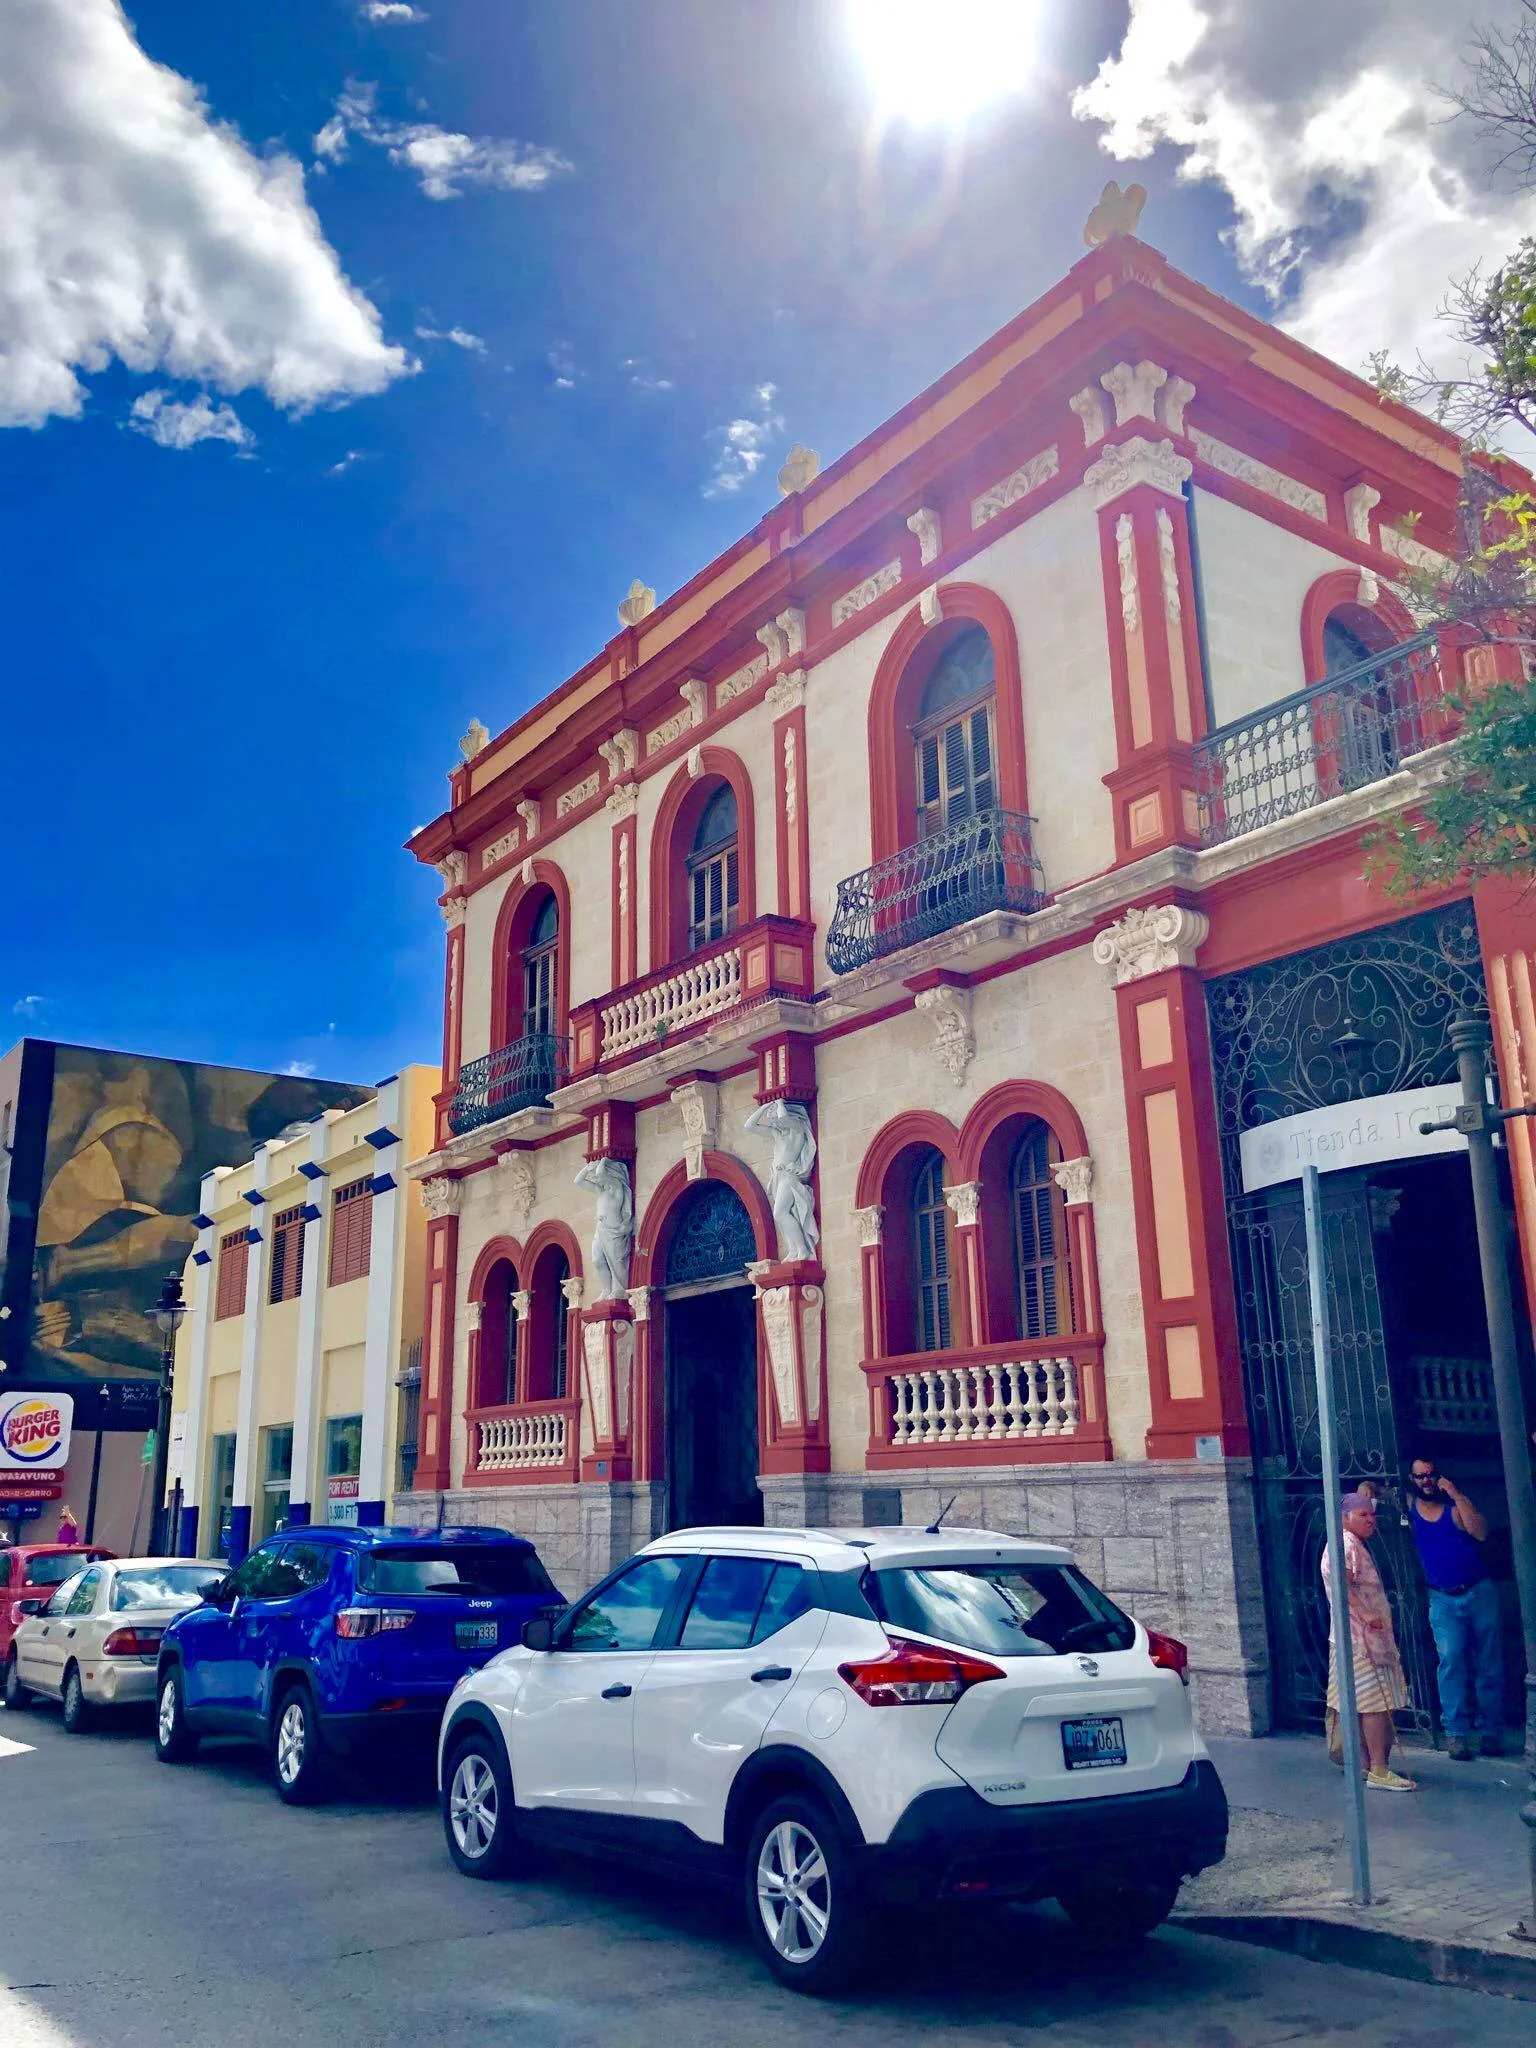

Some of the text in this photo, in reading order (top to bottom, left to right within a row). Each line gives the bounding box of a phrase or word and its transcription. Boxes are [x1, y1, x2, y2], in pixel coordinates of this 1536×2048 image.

[1289, 1118, 1383, 1160] Tienda
[7, 1420, 61, 1448] KING
[328, 1481, 359, 1495] FOR RENT
[468, 1600, 493, 1609] Jeep
[478, 1626, 496, 1640] 333
[1097, 1728, 1121, 1750] 061
[983, 1783, 1026, 1793] KICKS
